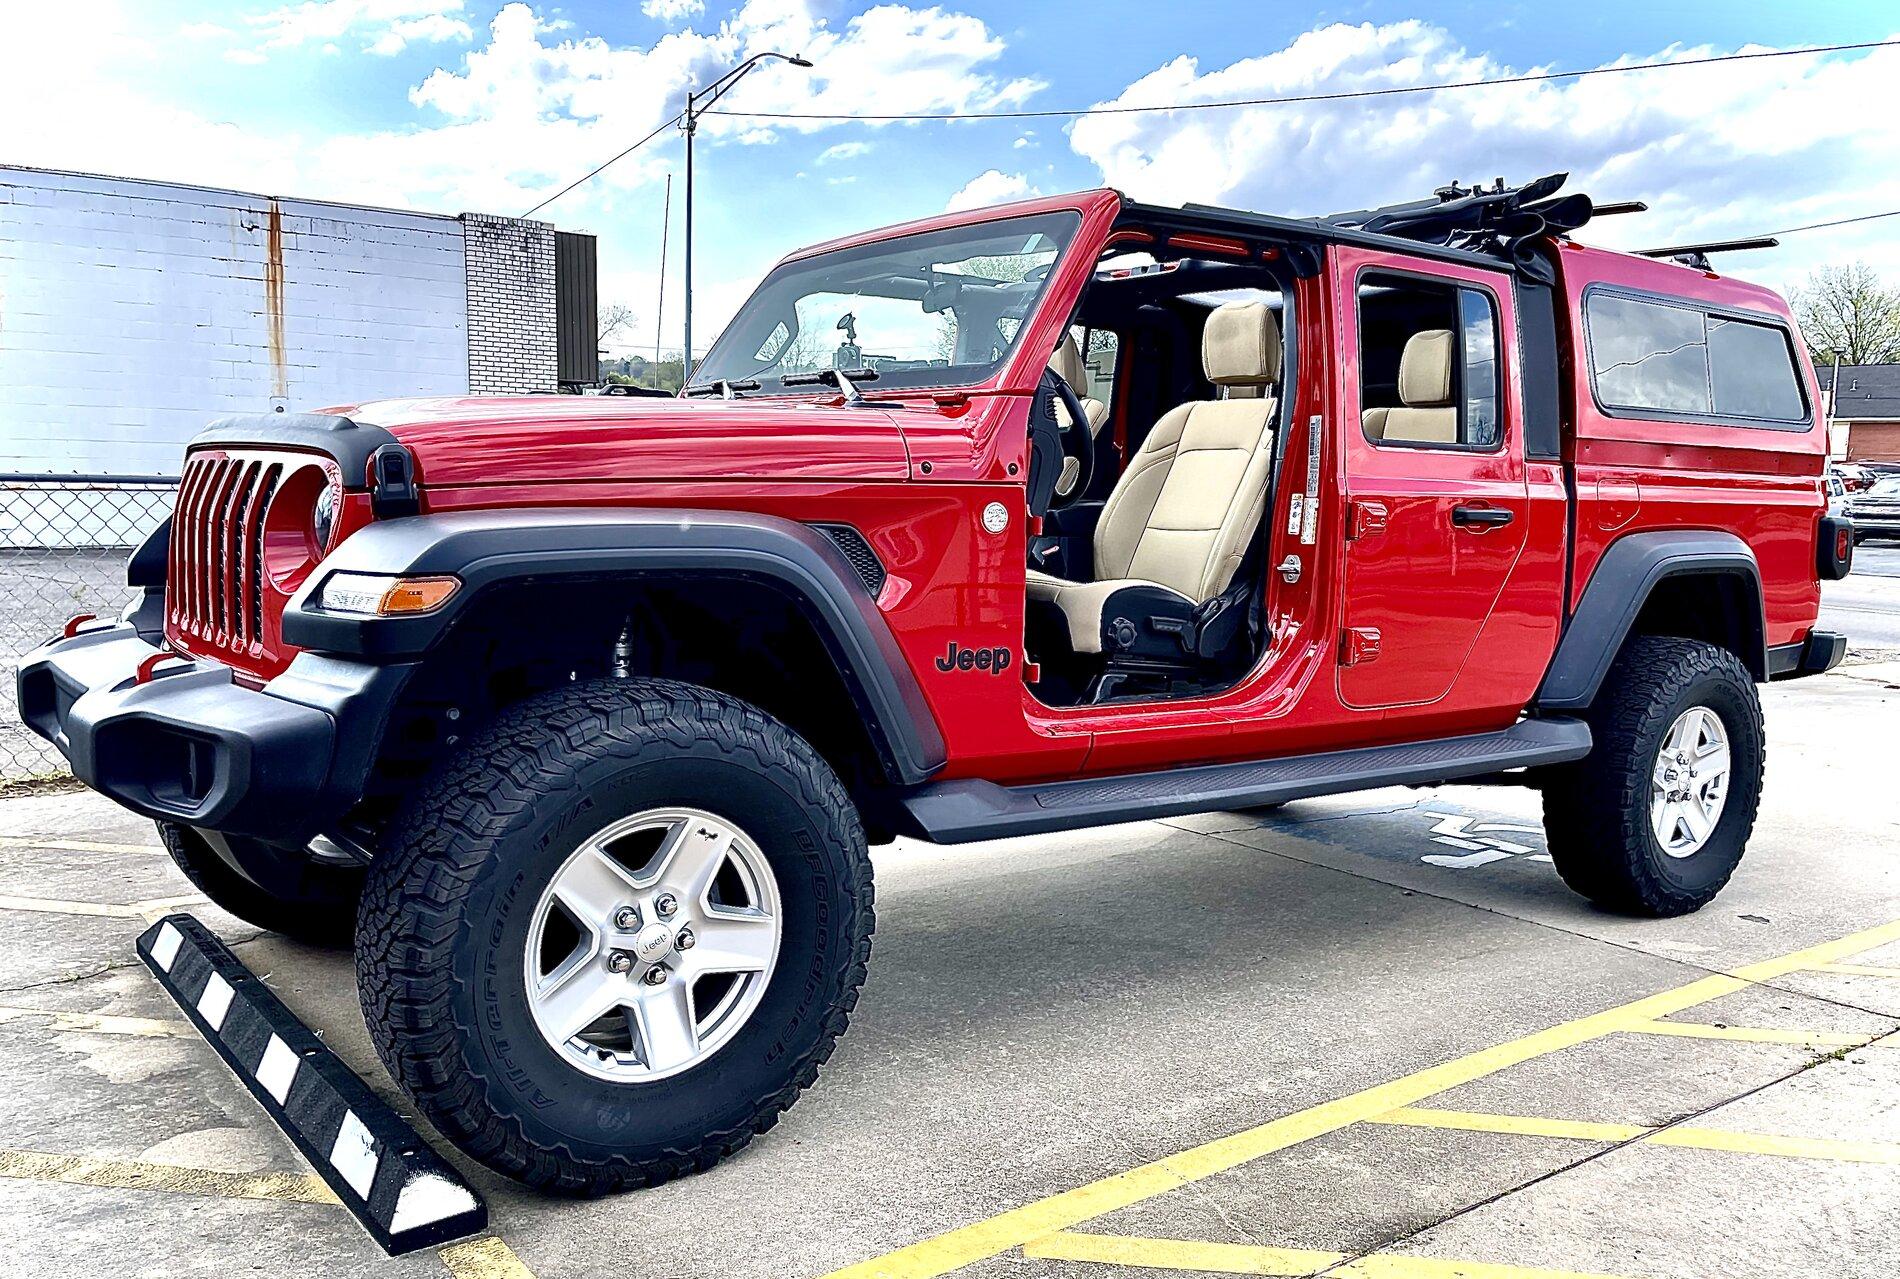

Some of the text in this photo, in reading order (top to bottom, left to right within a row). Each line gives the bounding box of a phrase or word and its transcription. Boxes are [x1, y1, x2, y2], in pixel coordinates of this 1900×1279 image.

[936, 642, 1011, 675] Jeep
[483, 870, 558, 1110] All-Terrain
[642, 933, 668, 955] Jeep
[764, 826, 829, 1066] BFGoodrich
